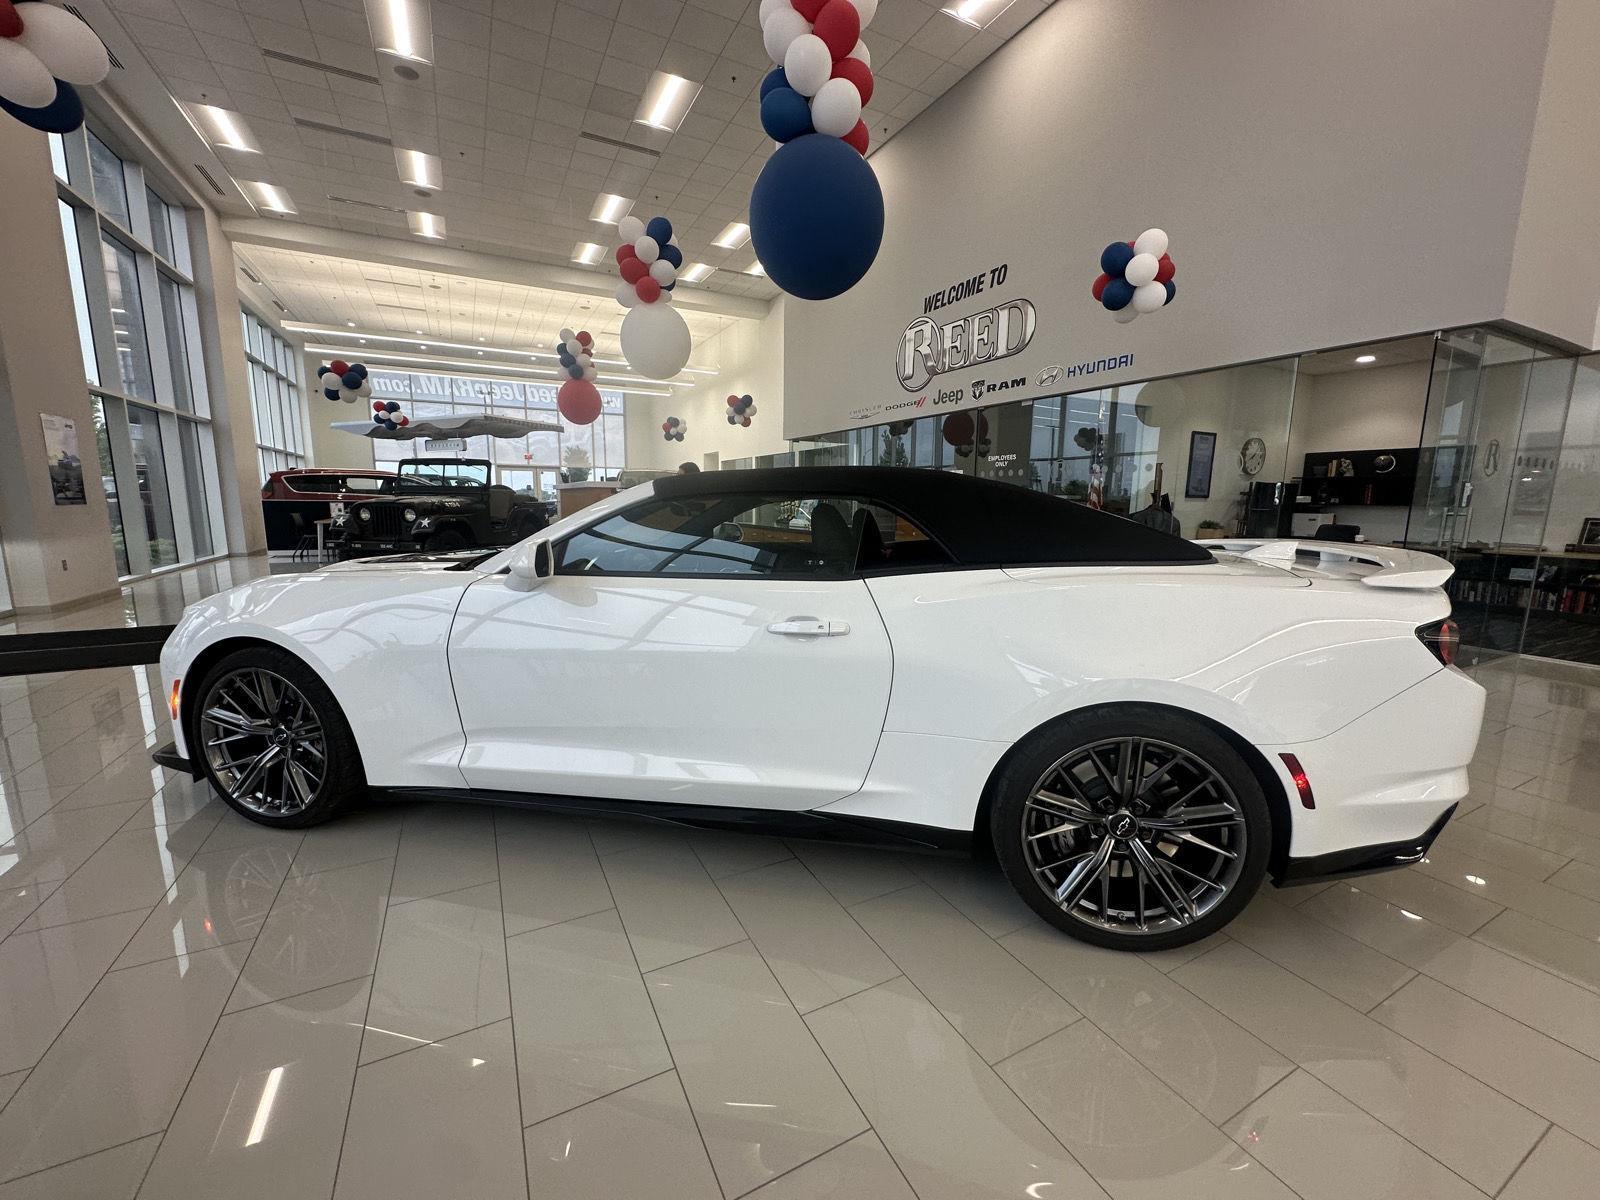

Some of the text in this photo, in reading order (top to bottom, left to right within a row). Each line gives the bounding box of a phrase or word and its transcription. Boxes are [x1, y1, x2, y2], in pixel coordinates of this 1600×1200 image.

[923, 263, 1008, 315] WELCOME TO
[896, 298, 1037, 392] REED
[885, 400, 921, 411] DODGE
[932, 388, 964, 405] Jeep
[986, 377, 1026, 393] RAM
[1067, 353, 1134, 378] HYUNDAI
[988, 453, 1017, 462] EMPLOYEES
